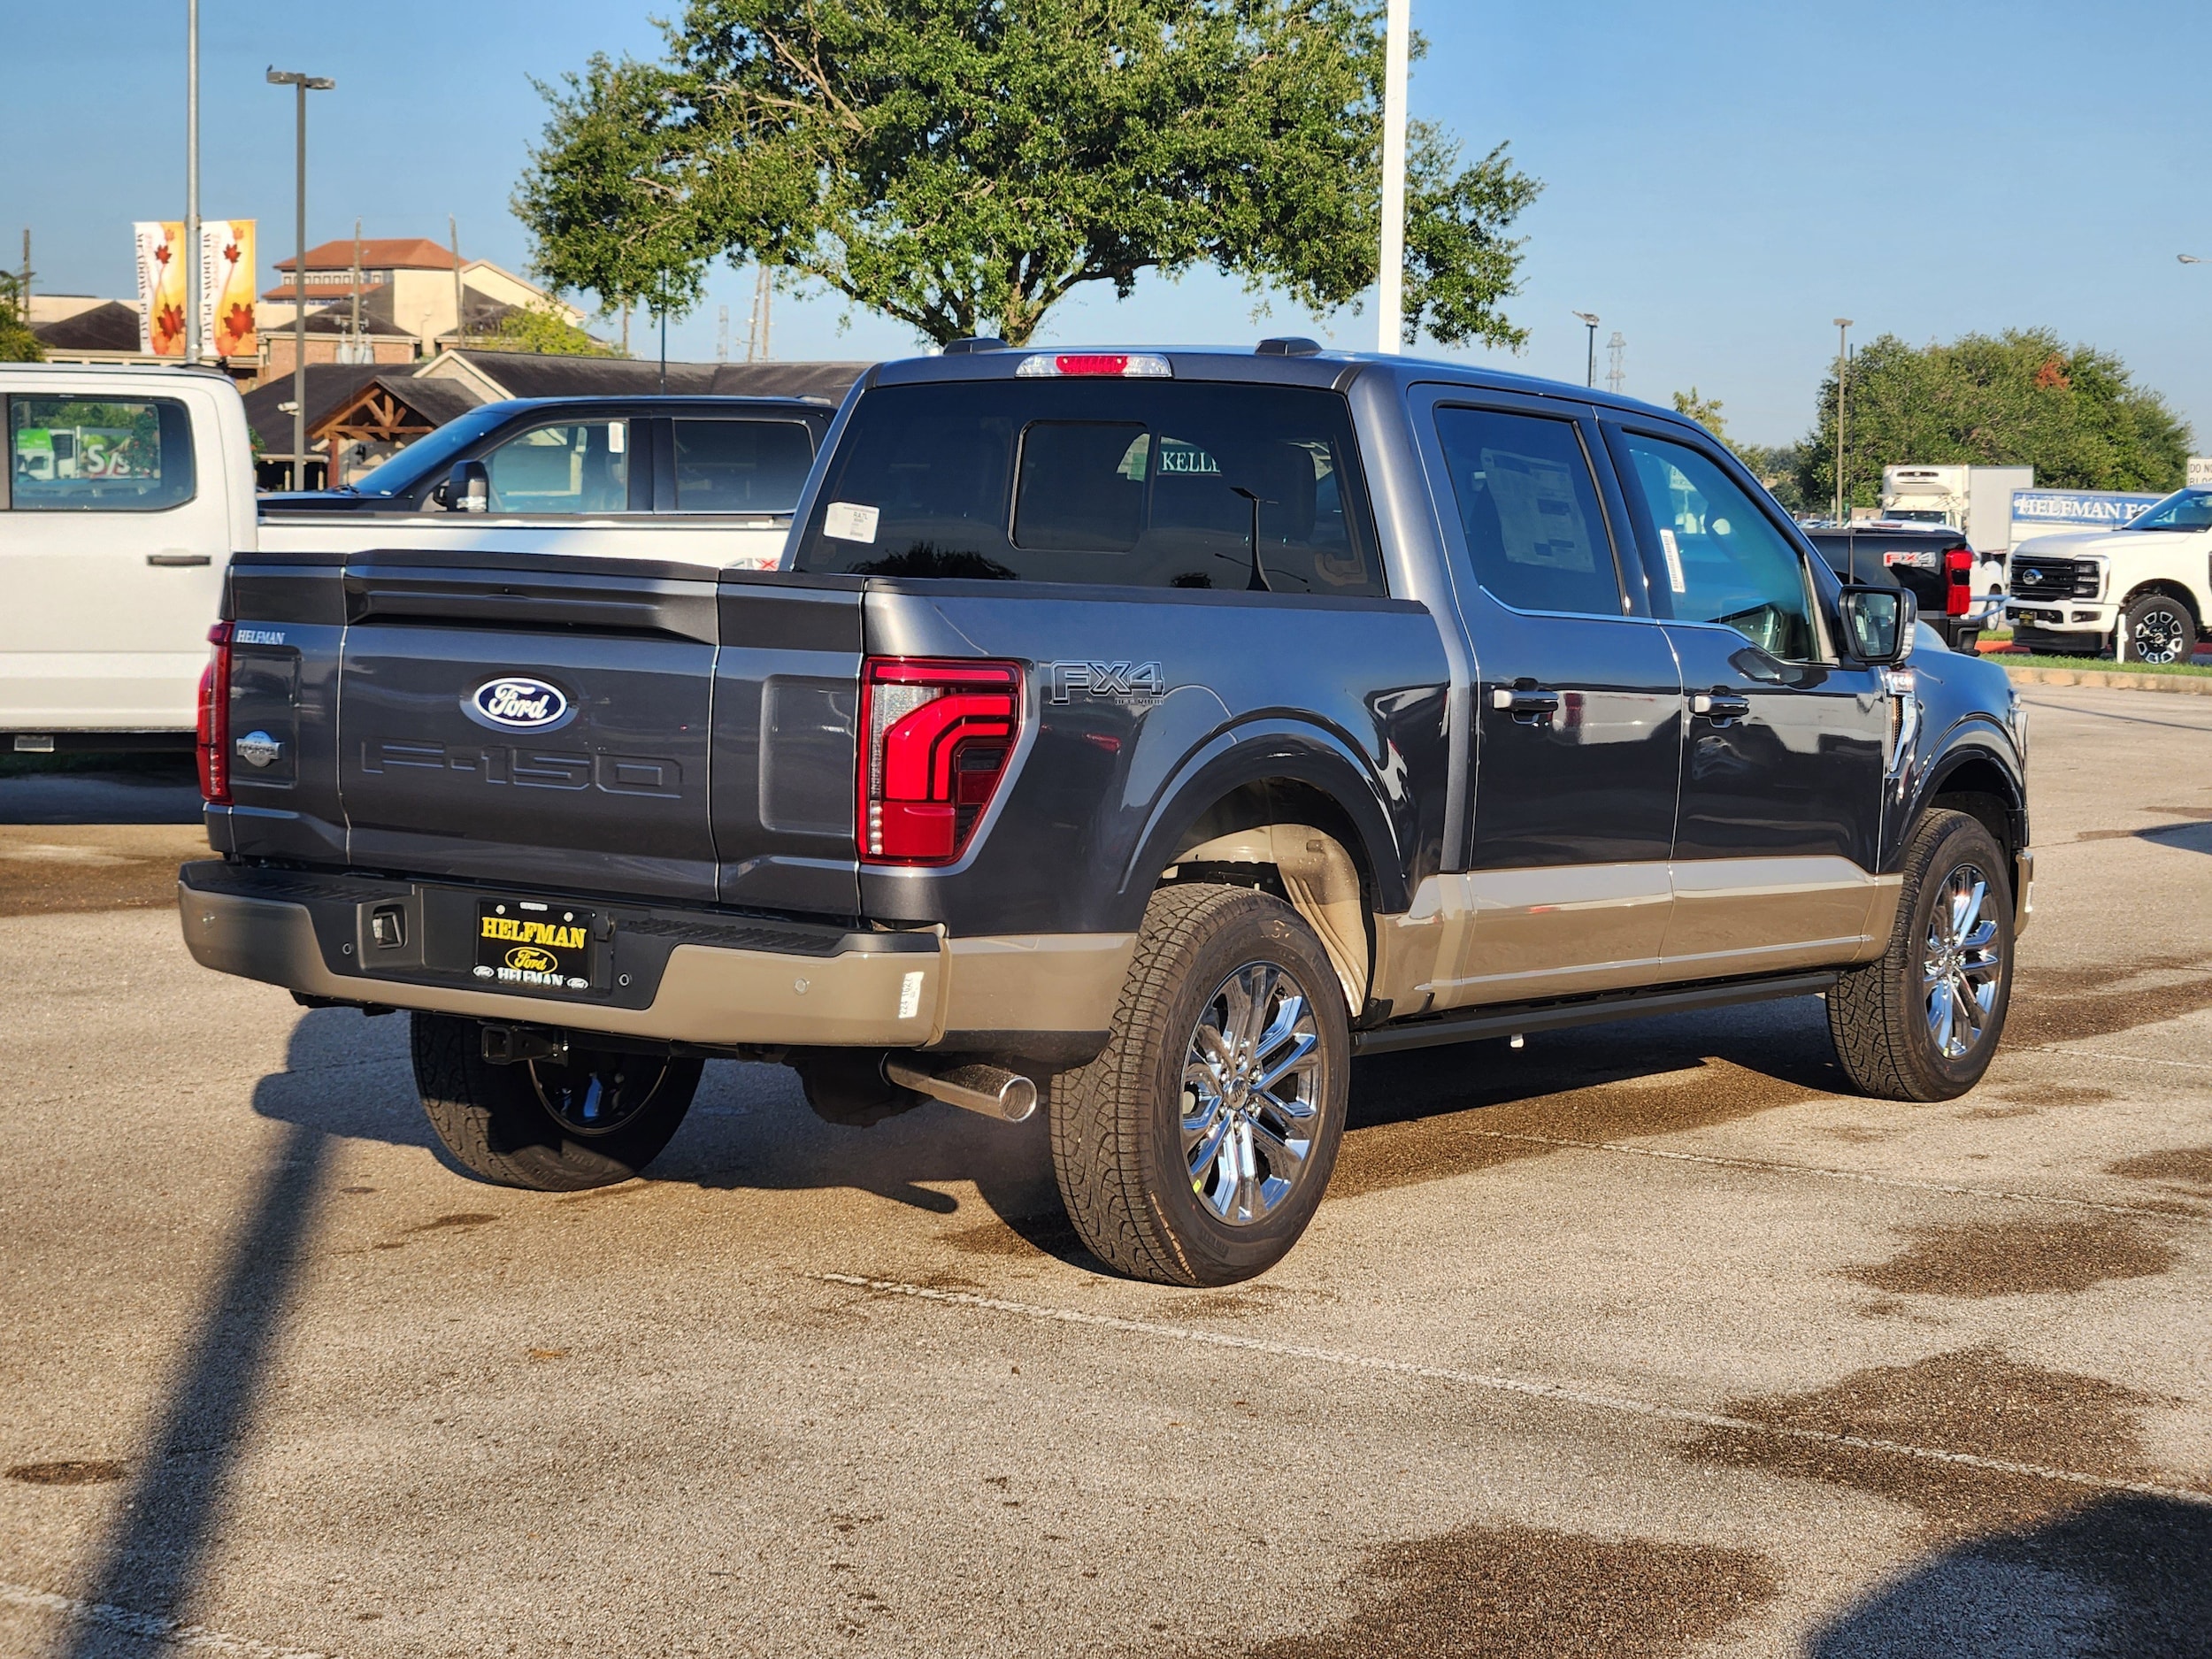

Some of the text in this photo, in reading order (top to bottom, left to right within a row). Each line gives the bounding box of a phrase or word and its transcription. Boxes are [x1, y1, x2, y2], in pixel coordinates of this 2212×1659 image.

[136, 234, 146, 299] MEADOWS
[203, 234, 212, 345] MEADOWS PLACE
[2190, 463, 2201, 473] DO
[2013, 494, 2122, 520] HELFMAN
[1883, 551, 1936, 567] FX4
[236, 629, 285, 645] HELFMAN
[1051, 659, 1165, 705] FX4
[361, 735, 684, 800] F-150
[480, 916, 588, 949] HELFMAN
[513, 949, 549, 972] Ford
[496, 967, 565, 987] HELFMAN
